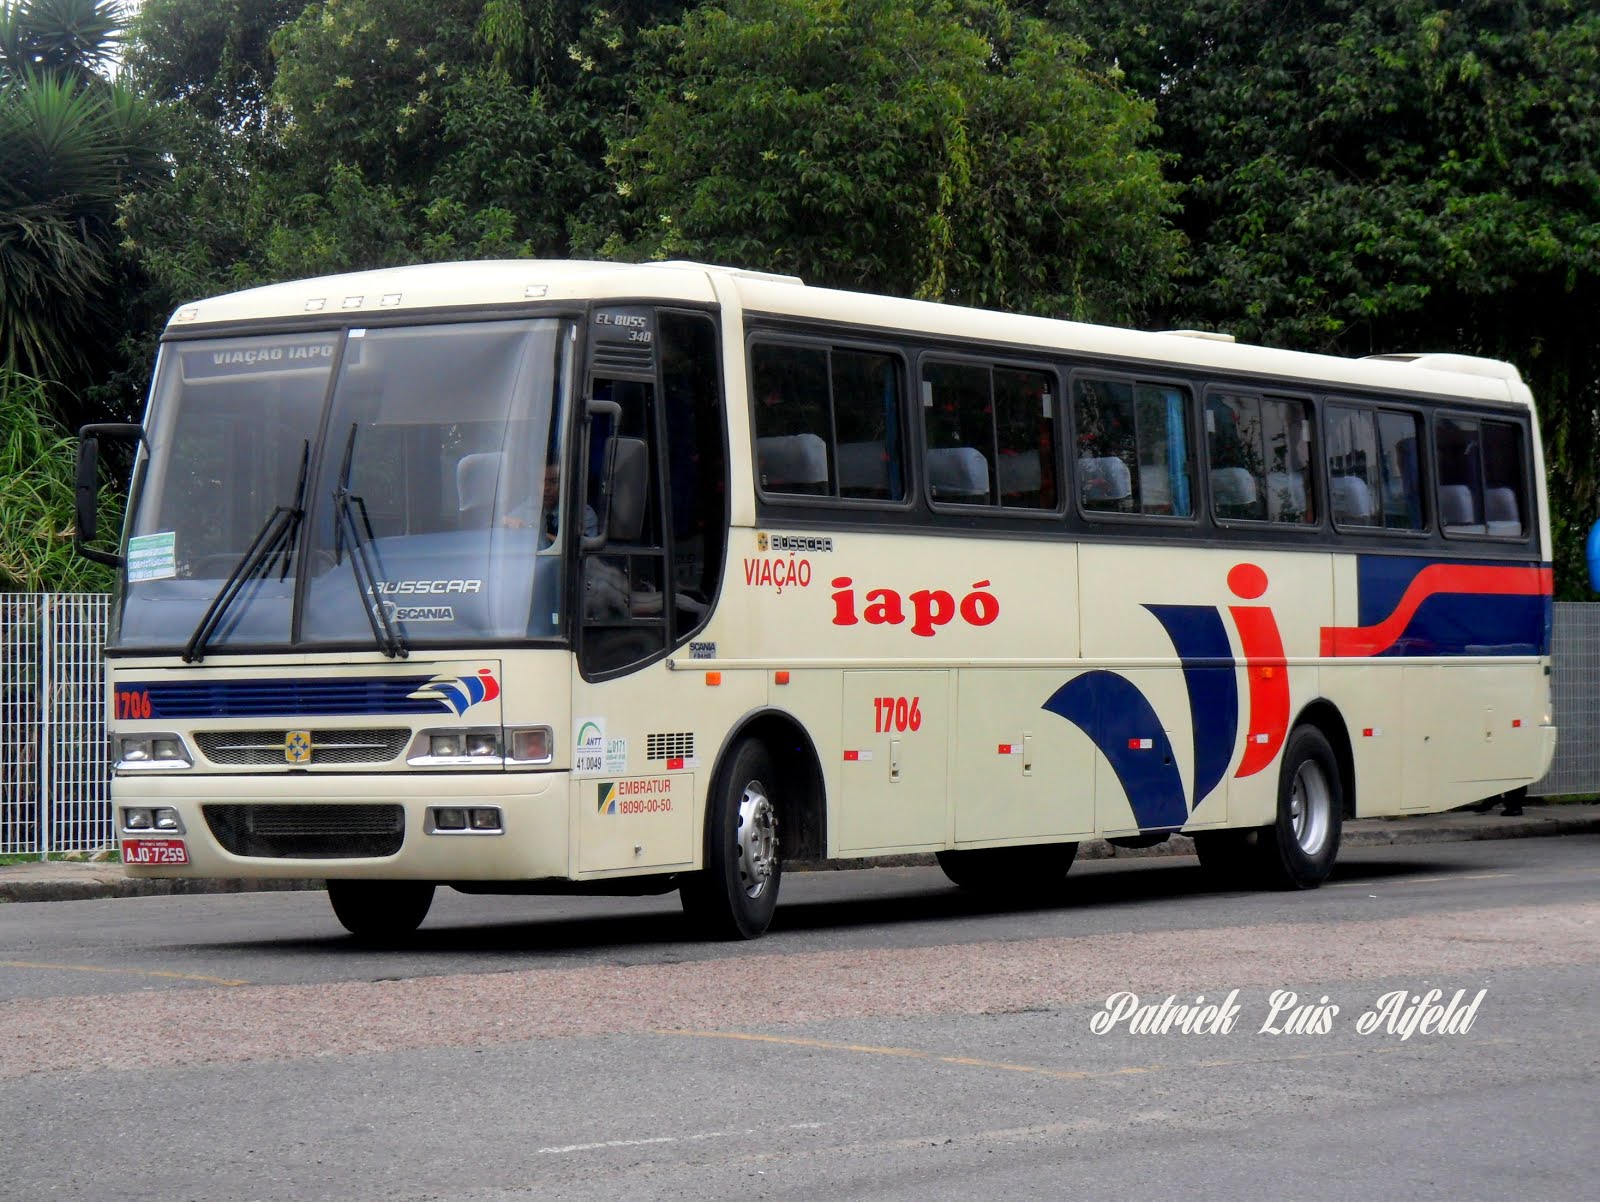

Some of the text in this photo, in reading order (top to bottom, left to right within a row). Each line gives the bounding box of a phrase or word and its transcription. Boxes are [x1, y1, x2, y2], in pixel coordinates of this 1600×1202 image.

[595, 313, 646, 328] EL BUSS
[628, 330, 651, 343] 340
[771, 535, 833, 552] BUSSCAR
[744, 552, 811, 594] VIAÇÃO
[397, 608, 452, 619] SCANIA
[831, 576, 1000, 637] iapó
[690, 642, 716, 651] SCANIA
[114, 690, 151, 720] 1706
[874, 696, 922, 733] 1706
[586, 737, 602, 746] ANTT
[576, 756, 602, 771] 41.0049
[618, 779, 671, 796] EMBRATUR
